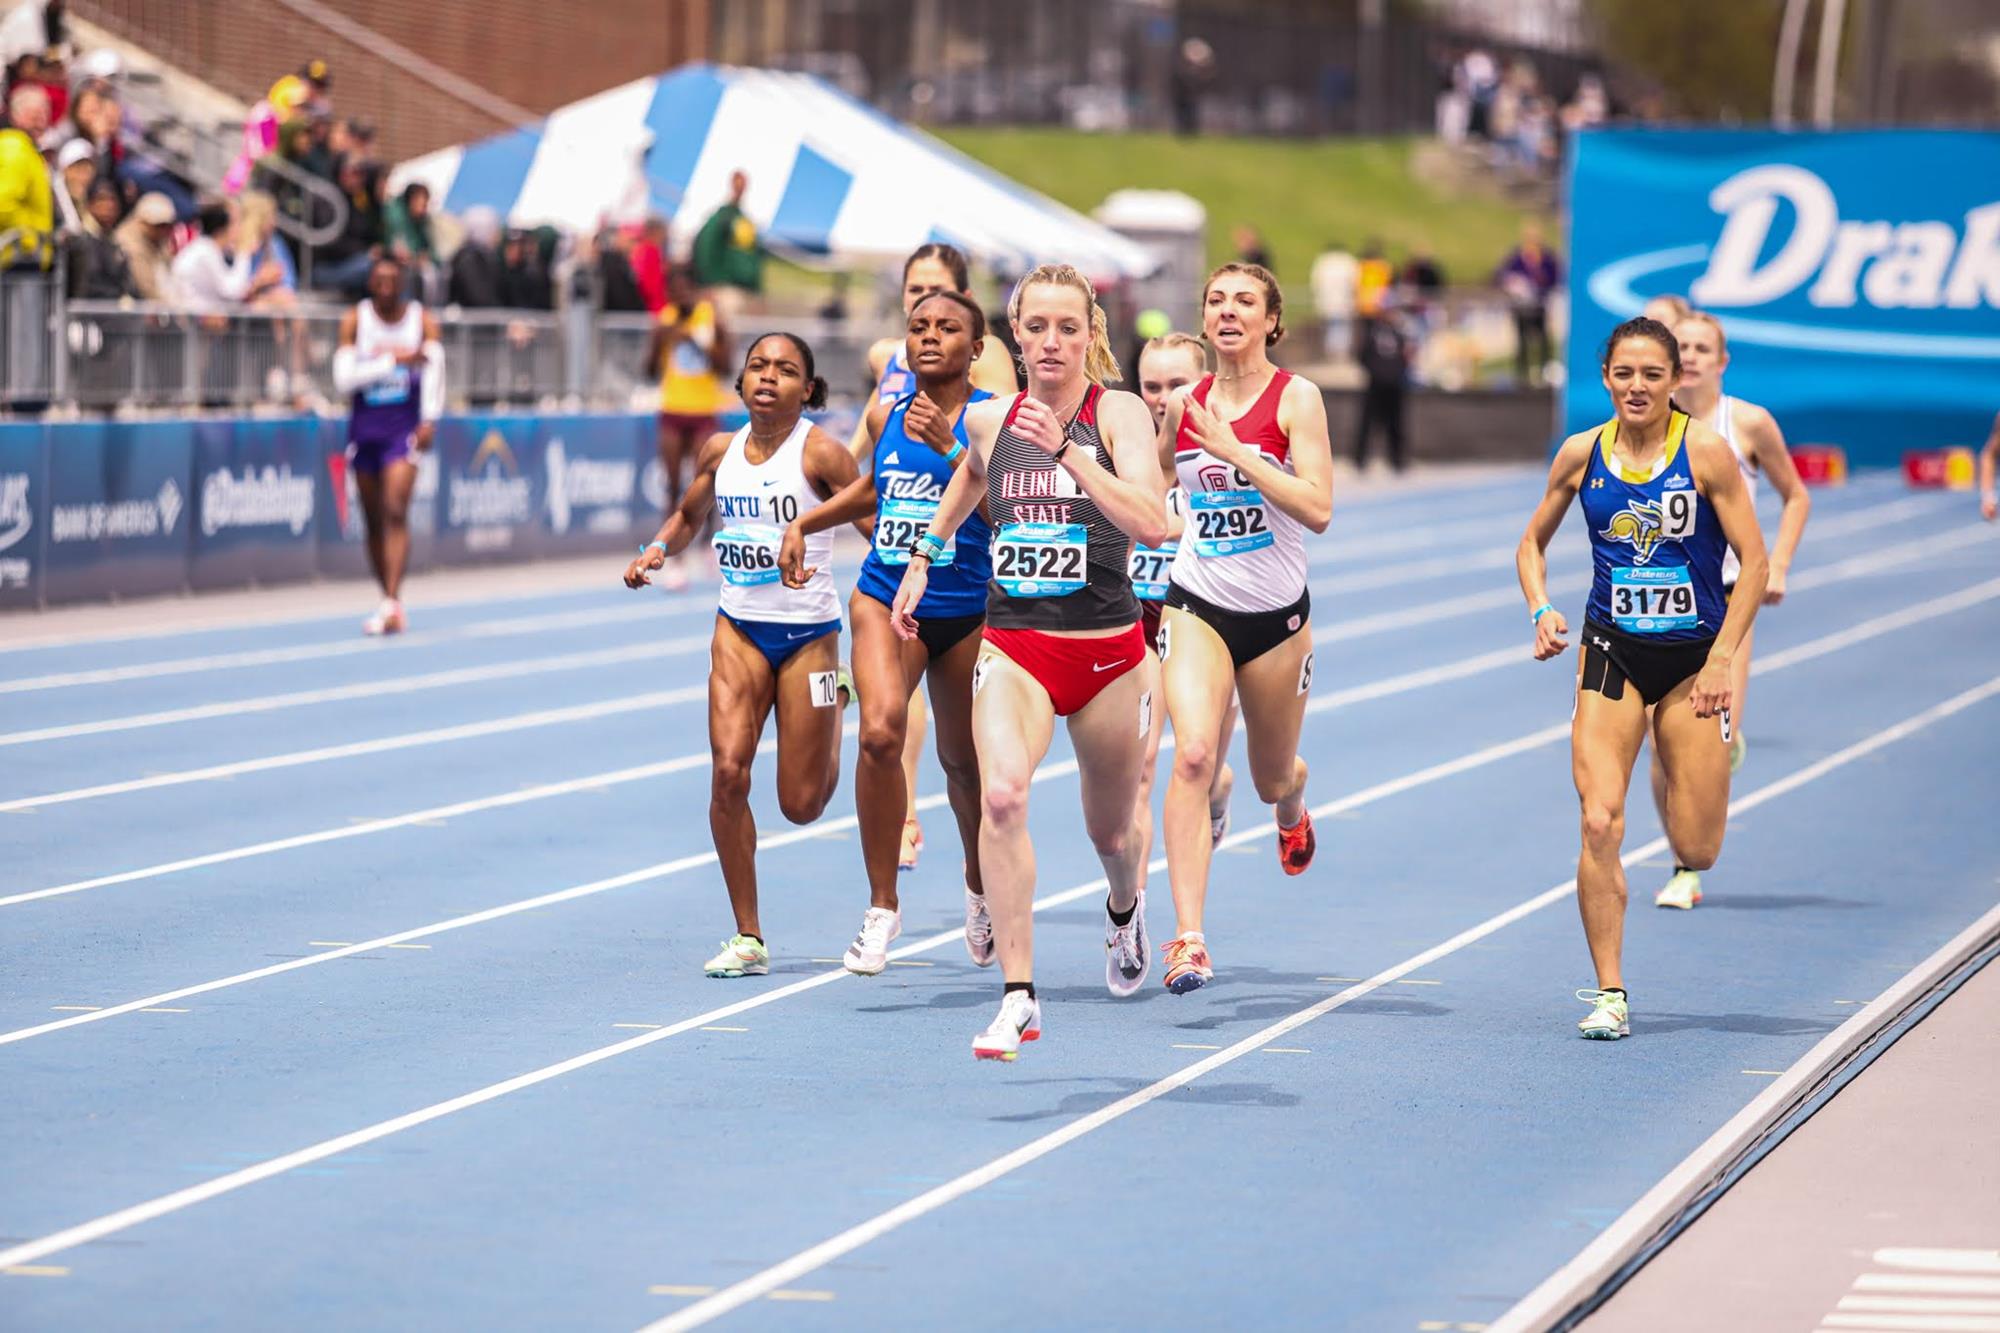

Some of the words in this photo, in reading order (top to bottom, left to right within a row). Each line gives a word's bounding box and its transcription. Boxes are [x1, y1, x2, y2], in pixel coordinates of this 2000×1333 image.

[1688, 163, 2000, 309] Drak
[769, 495, 798, 523] 10
[1197, 508, 1267, 539] 2292
[1669, 493, 1689, 535] 9
[715, 543, 774, 570] 2666
[997, 546, 1081, 579] 2522
[1616, 587, 1692, 615] 3179
[820, 673, 835, 703] 10
